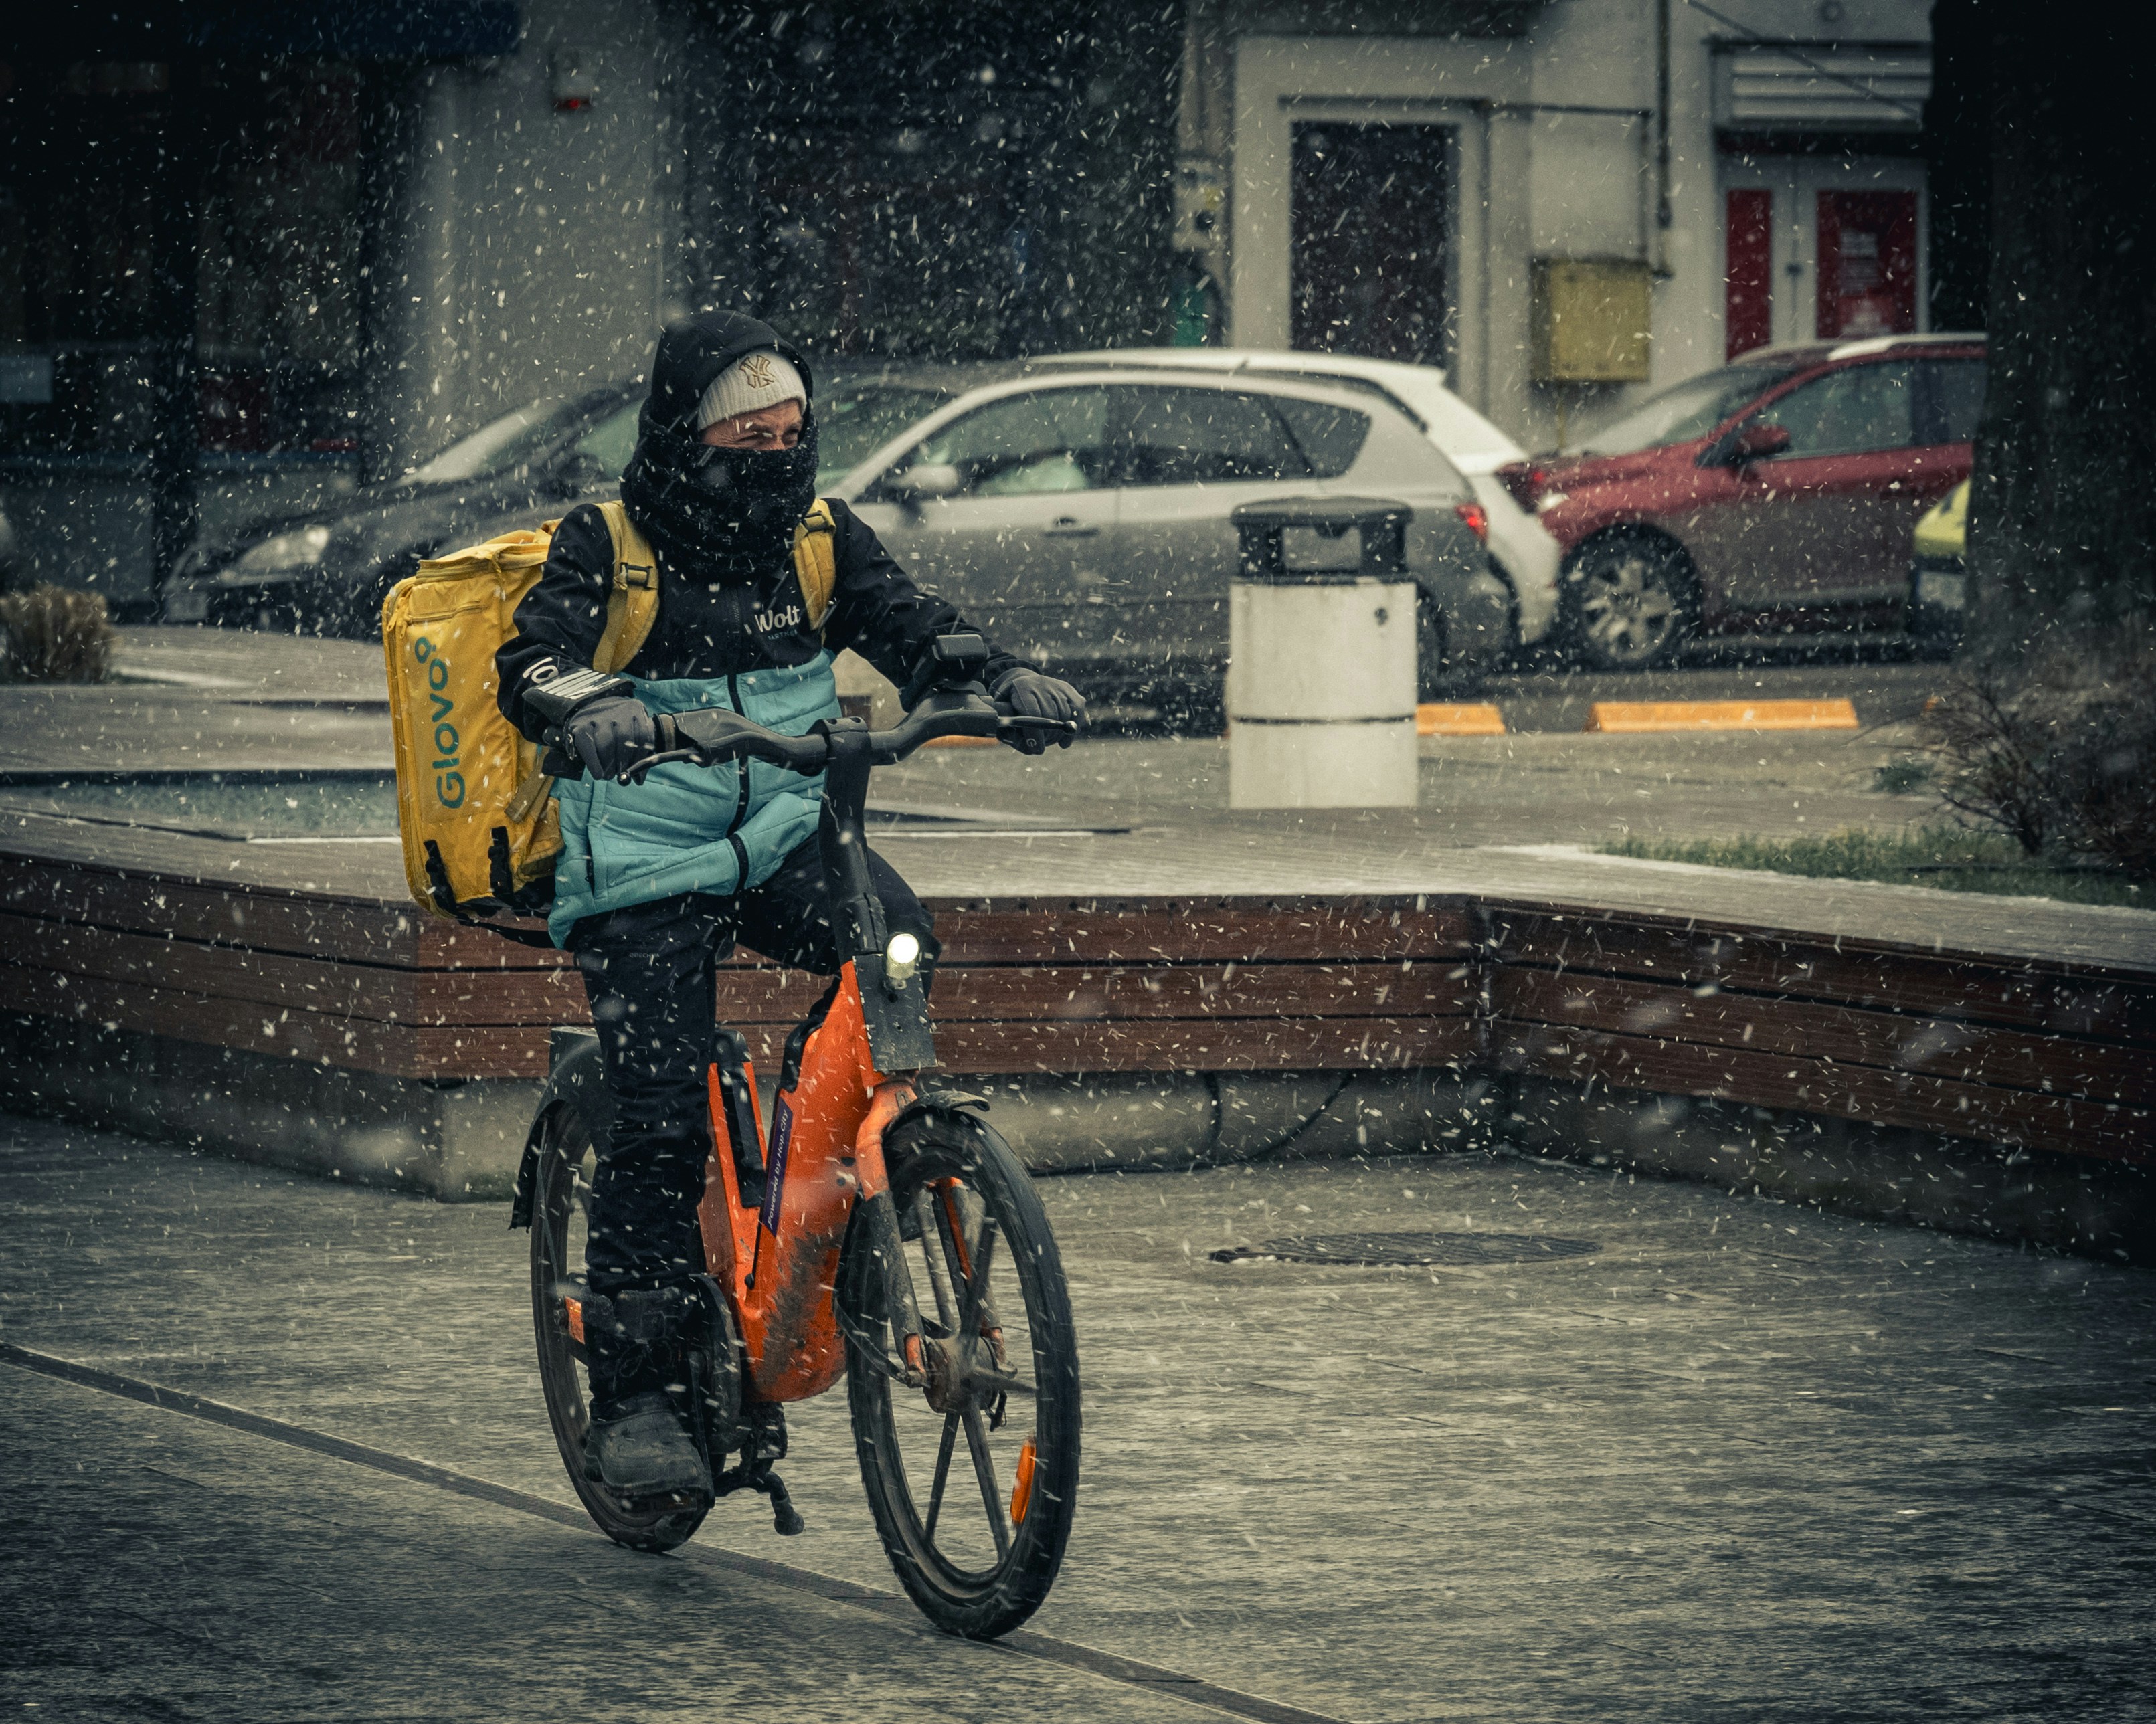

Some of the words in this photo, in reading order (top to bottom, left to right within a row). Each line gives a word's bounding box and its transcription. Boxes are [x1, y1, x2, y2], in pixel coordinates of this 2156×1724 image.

[739, 355, 776, 389] NY
[755, 605, 801, 632] Wolt
[428, 658, 466, 809] Glovo
[774, 1159, 782, 1175] by
